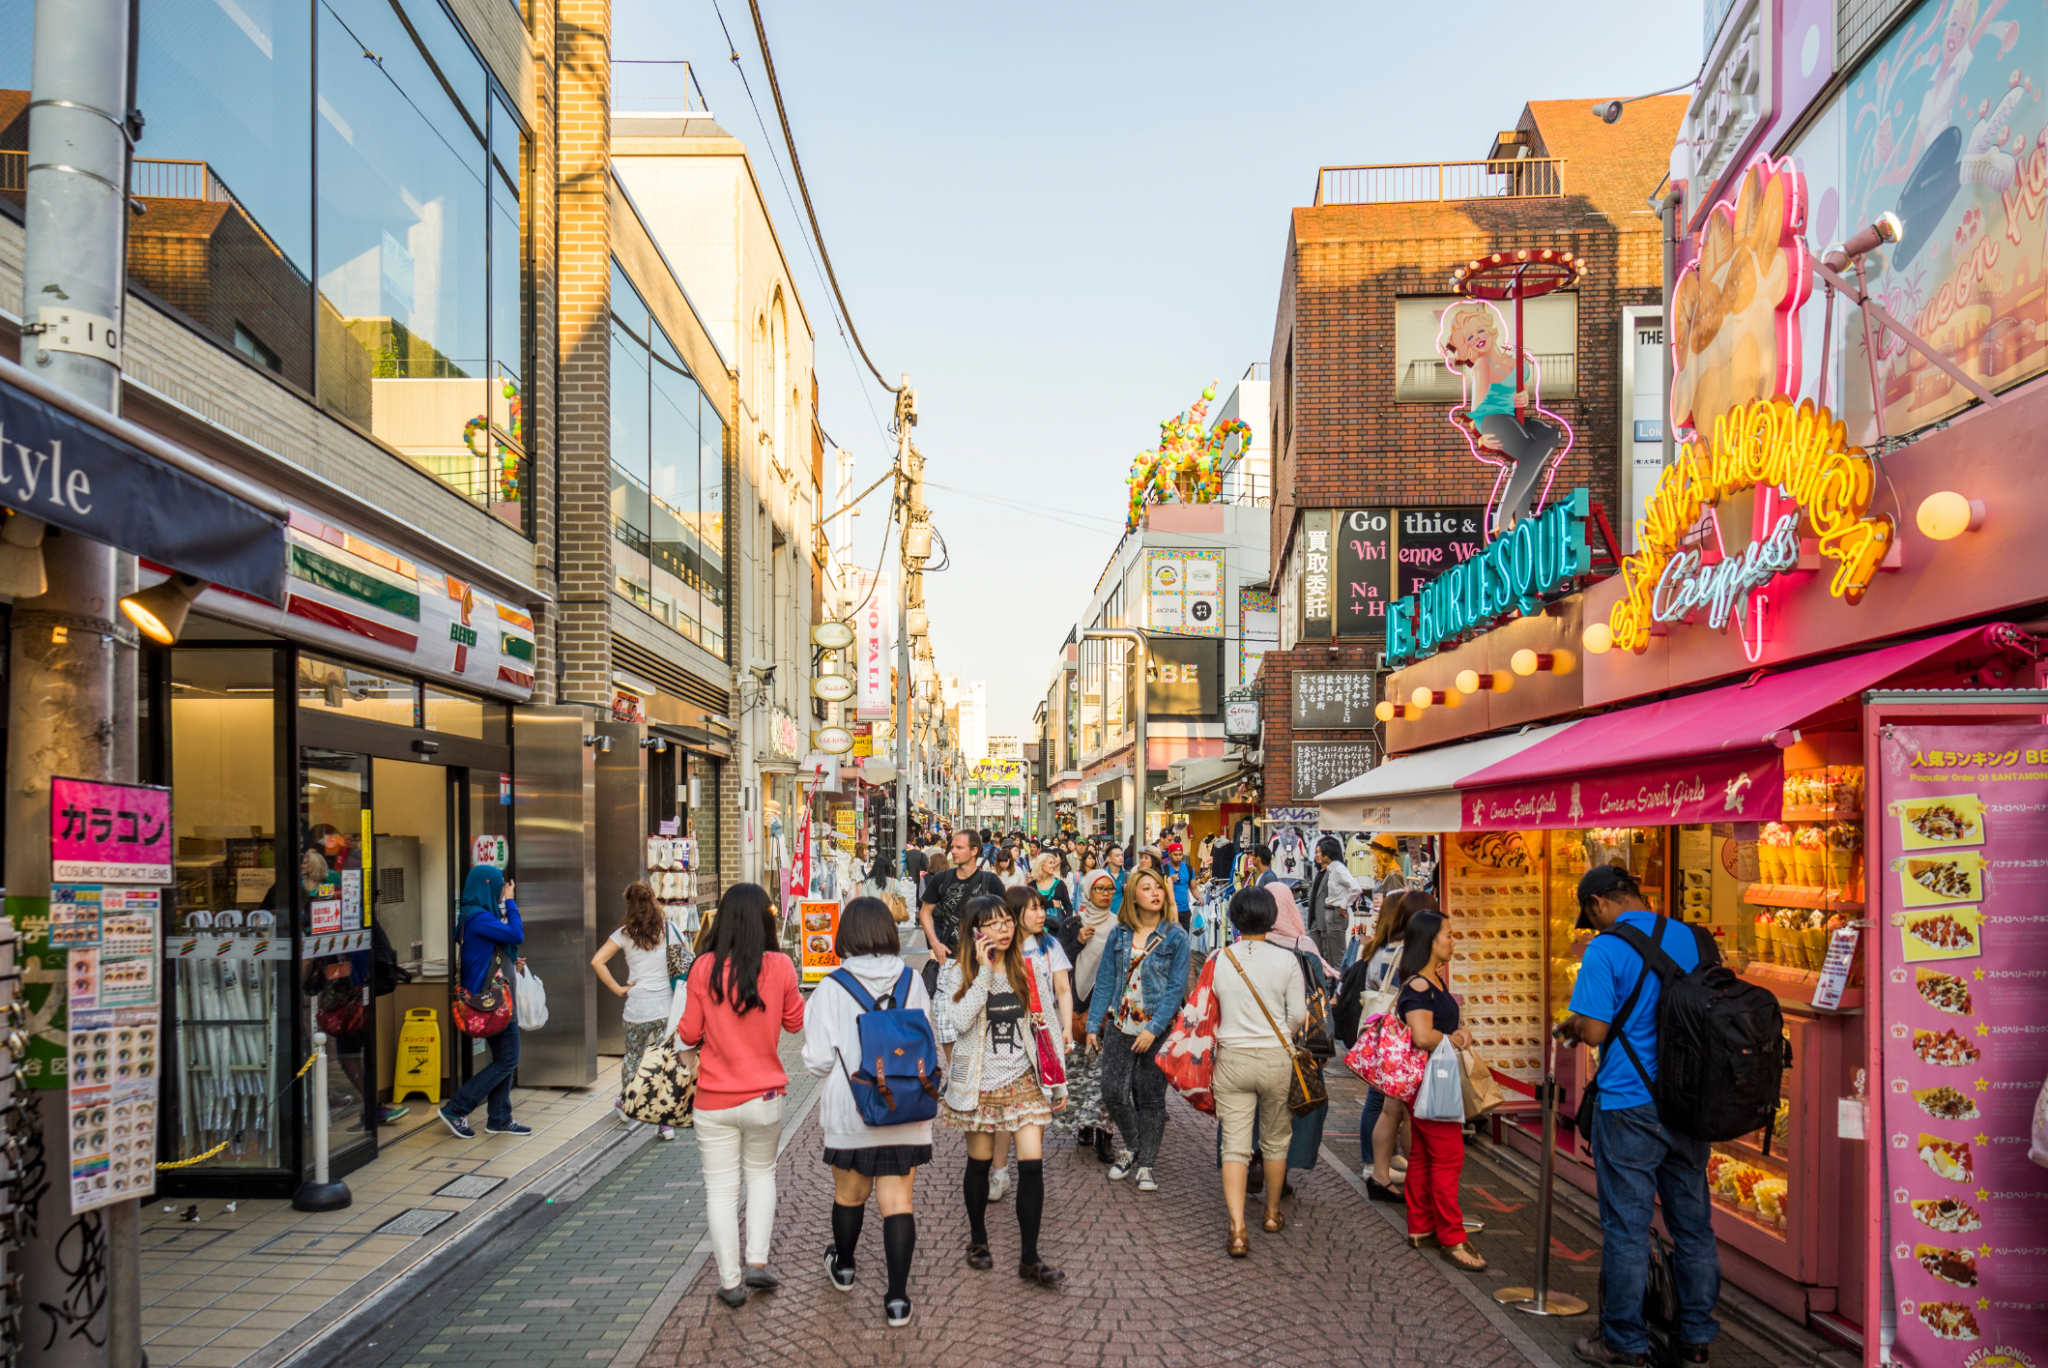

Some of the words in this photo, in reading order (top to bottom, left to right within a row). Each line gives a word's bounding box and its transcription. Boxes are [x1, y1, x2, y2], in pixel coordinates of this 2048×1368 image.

[1304, 530, 1329, 618] 買取委託
[1420, 486, 1590, 653] BURLESQUE
[868, 594, 879, 629] NO
[868, 636, 880, 694] FALL
[972, 764, 1021, 774] ムラサスポーツ
[1910, 750, 2021, 768] 人気ランキング
[1909, 774, 1949, 782] Popular
[1951, 773, 1975, 781] Order
[61, 803, 165, 846] カラコン
[109, 867, 147, 880] CONTACT
[148, 867, 169, 880] LENS
